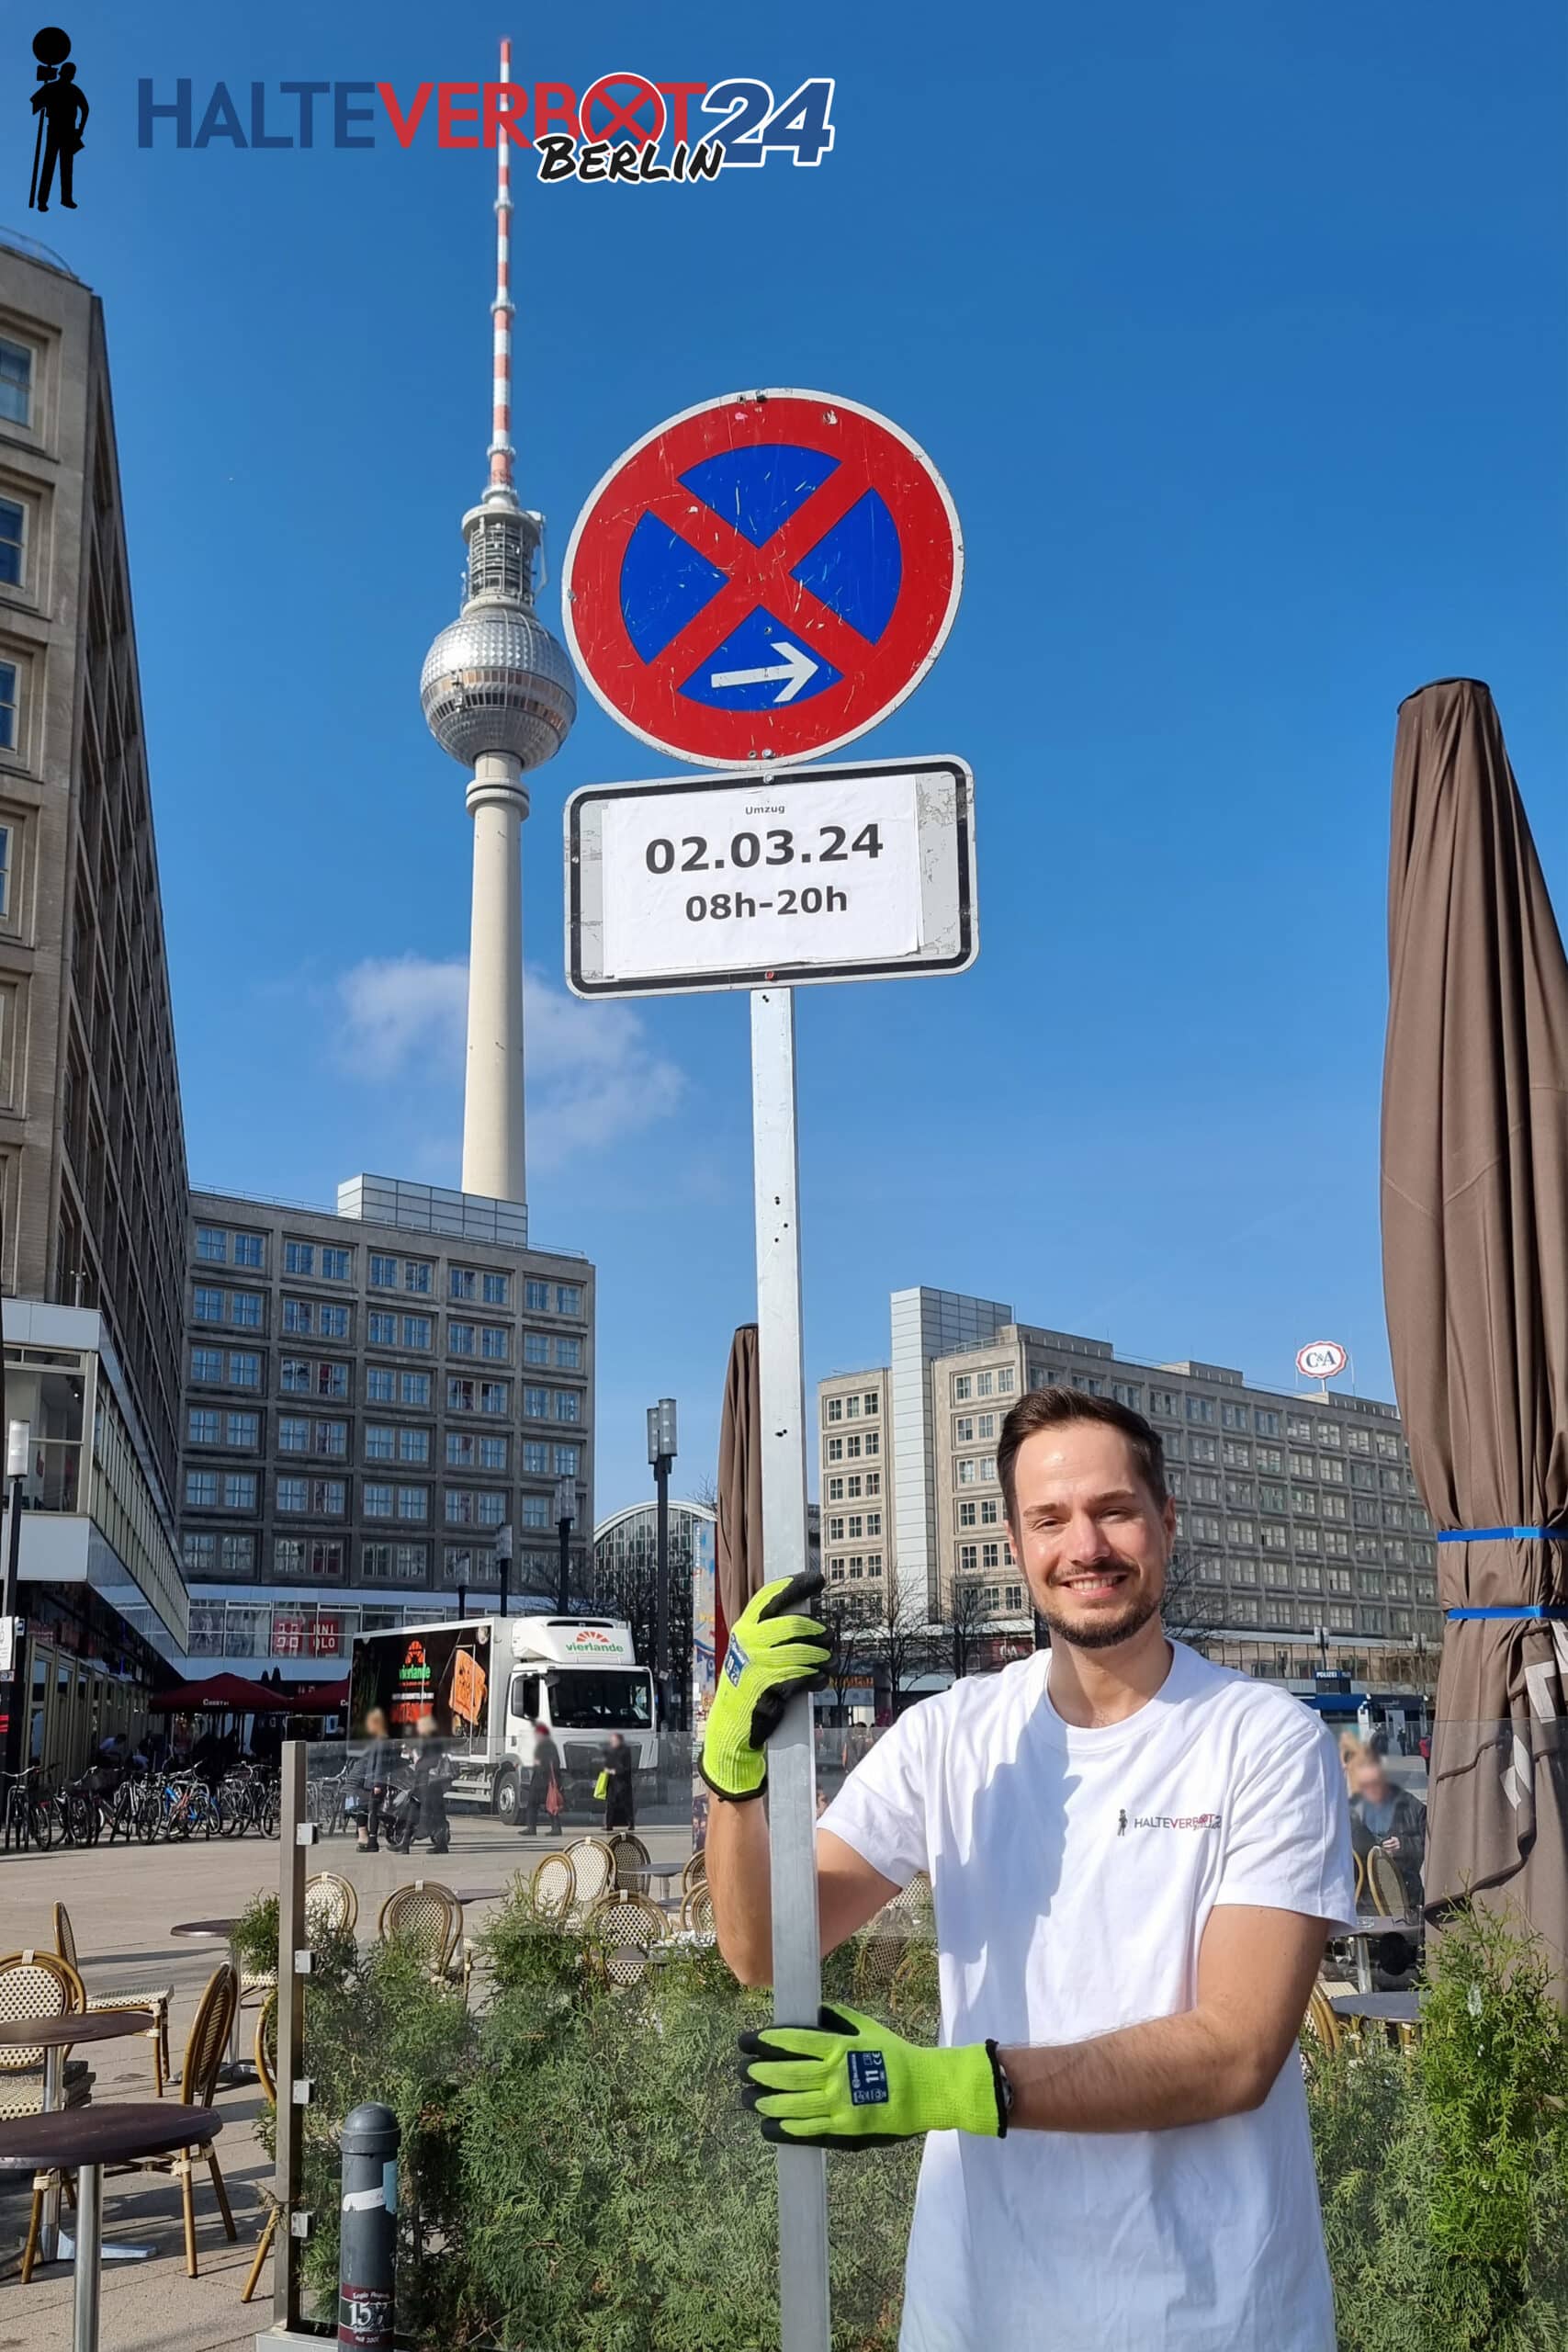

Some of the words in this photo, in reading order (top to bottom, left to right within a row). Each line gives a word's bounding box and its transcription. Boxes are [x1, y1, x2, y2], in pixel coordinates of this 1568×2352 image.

[744, 803, 785, 816] Umzug
[645, 823, 884, 875] 02.03.24
[685, 885, 848, 922] 08h-20h
[1305, 1350, 1337, 1368] C&A
[566, 1642, 624, 1652] vierlande
[864, 2070, 879, 2083] 11
